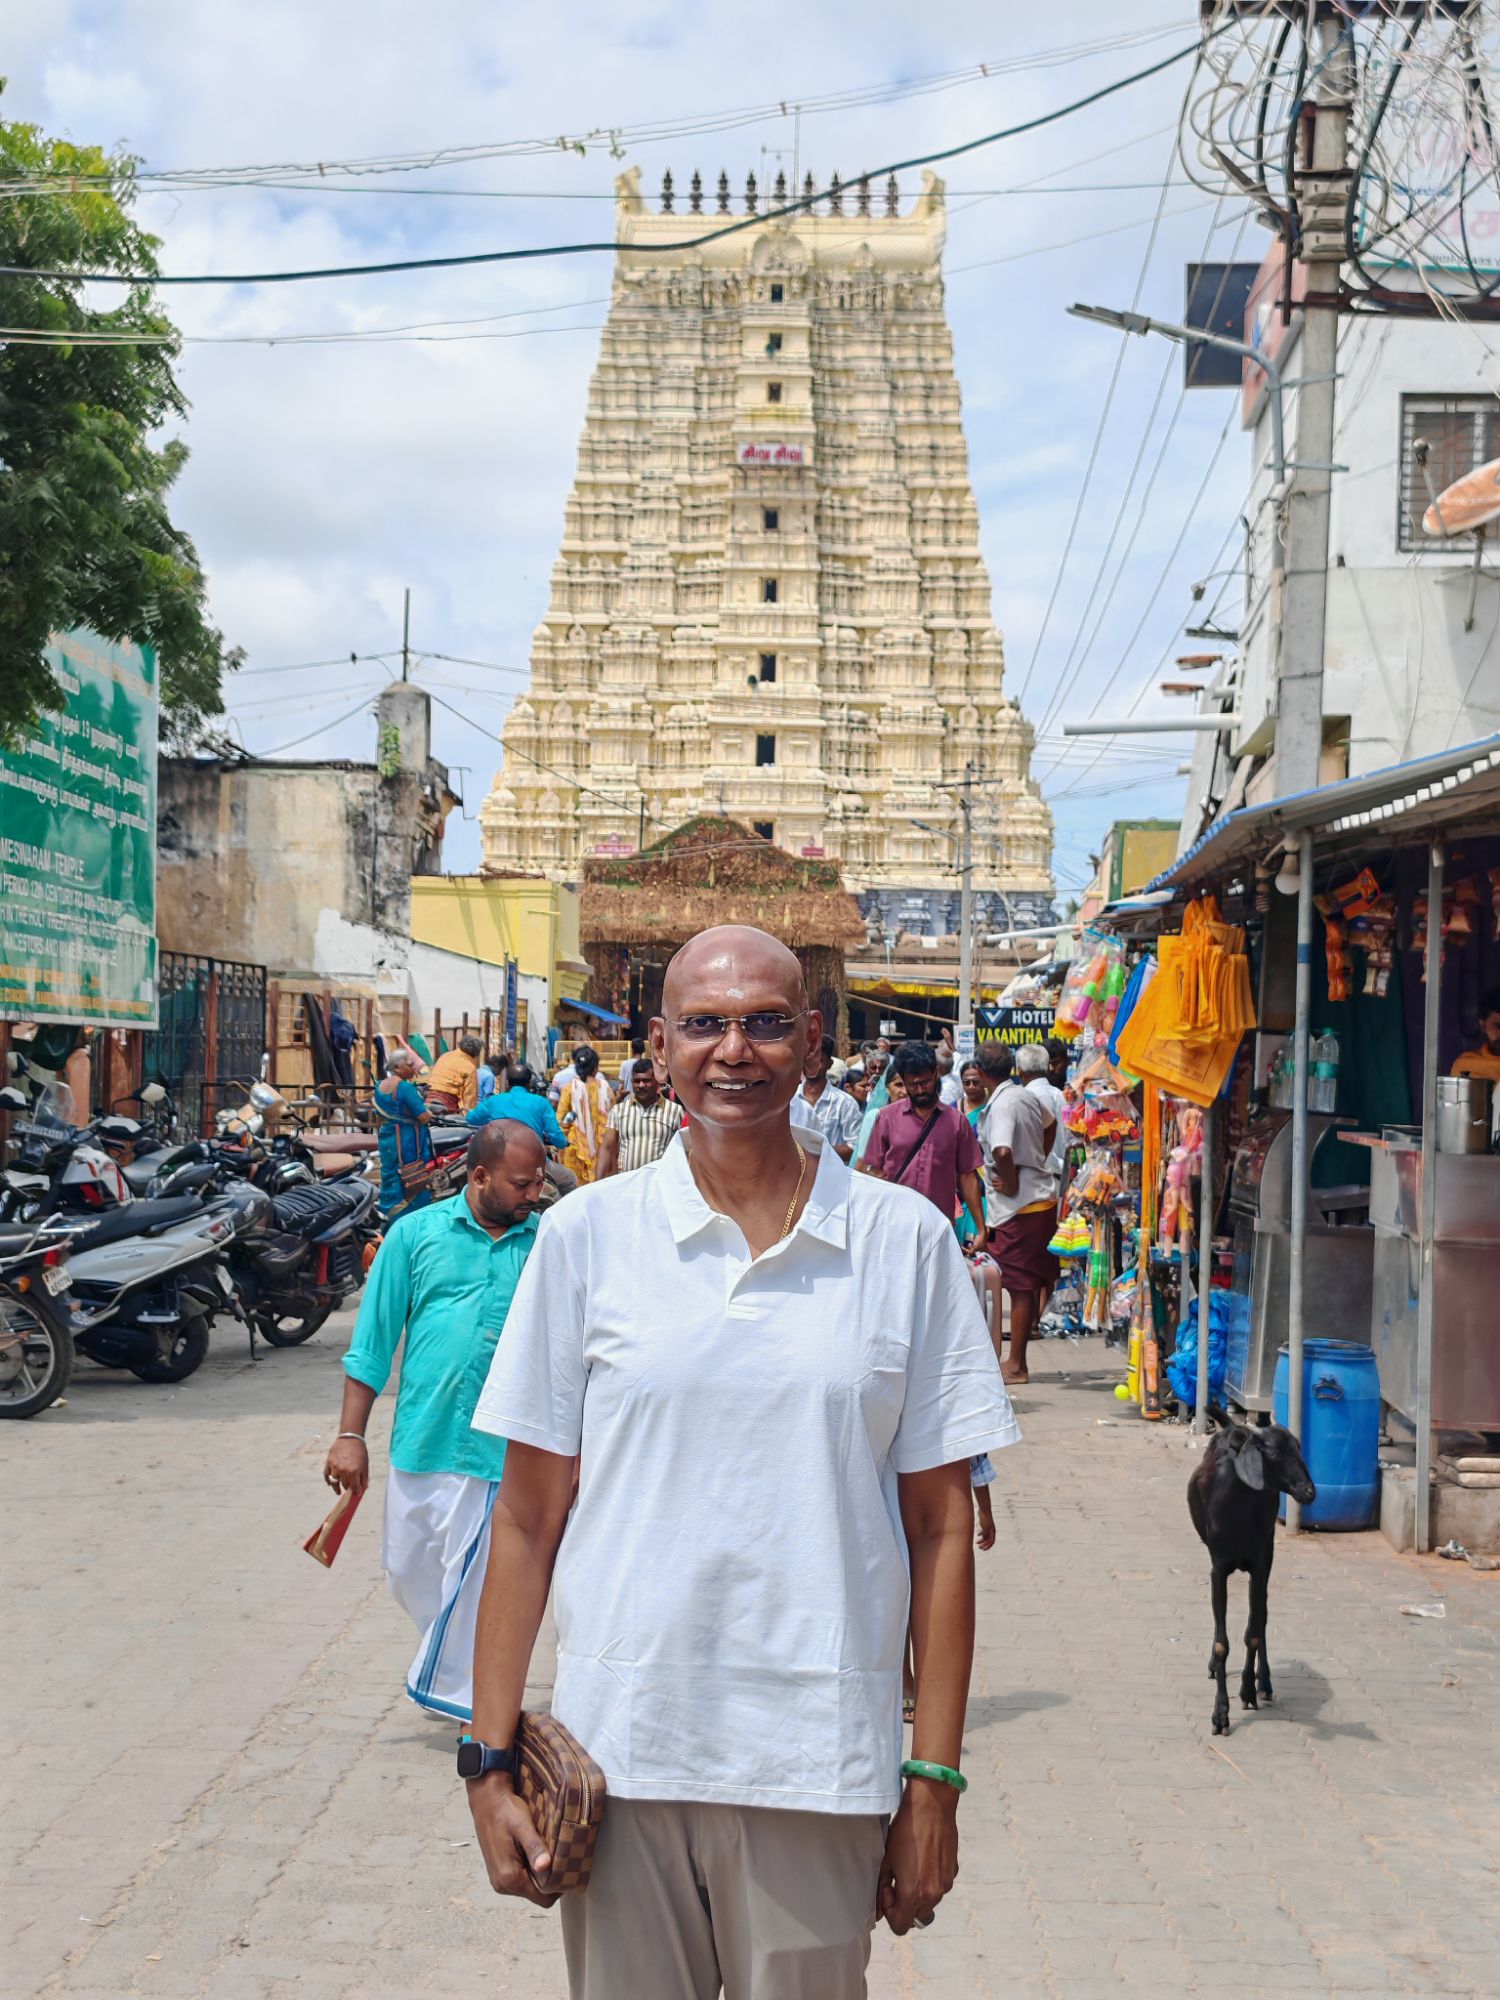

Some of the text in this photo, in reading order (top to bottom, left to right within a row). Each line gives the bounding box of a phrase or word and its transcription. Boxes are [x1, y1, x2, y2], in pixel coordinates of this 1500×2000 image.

[54, 851, 84, 882] TEMPLE
[1012, 1010, 1054, 1025] HOTEL
[977, 1028, 1043, 1045] VASANTHA
